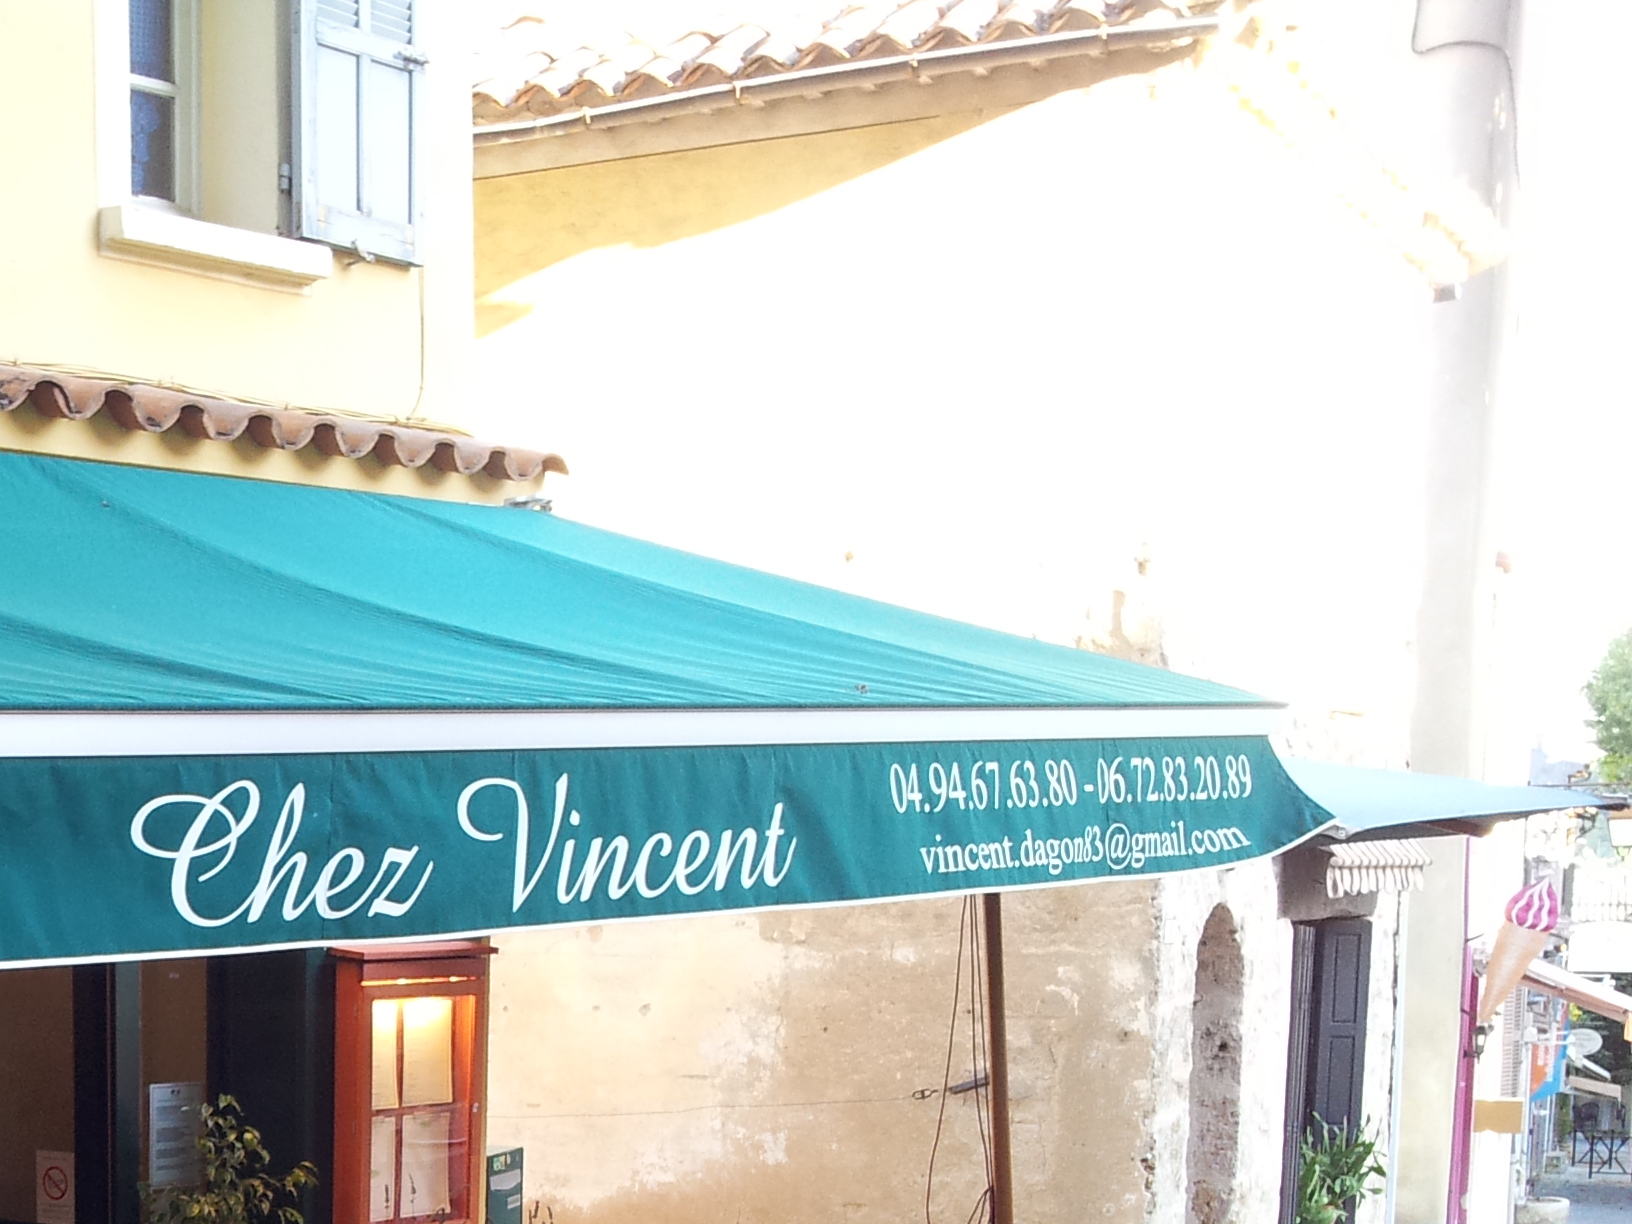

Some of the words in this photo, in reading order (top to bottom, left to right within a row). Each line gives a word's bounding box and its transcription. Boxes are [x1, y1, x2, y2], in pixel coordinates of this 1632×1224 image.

[889, 759, 1078, 814] 04.94.67.63.80
[130, 779, 434, 927] Chez
[456, 772, 797, 912] Vincent
[919, 820, 1252, 875] vincent.dagon83@gmail.com
